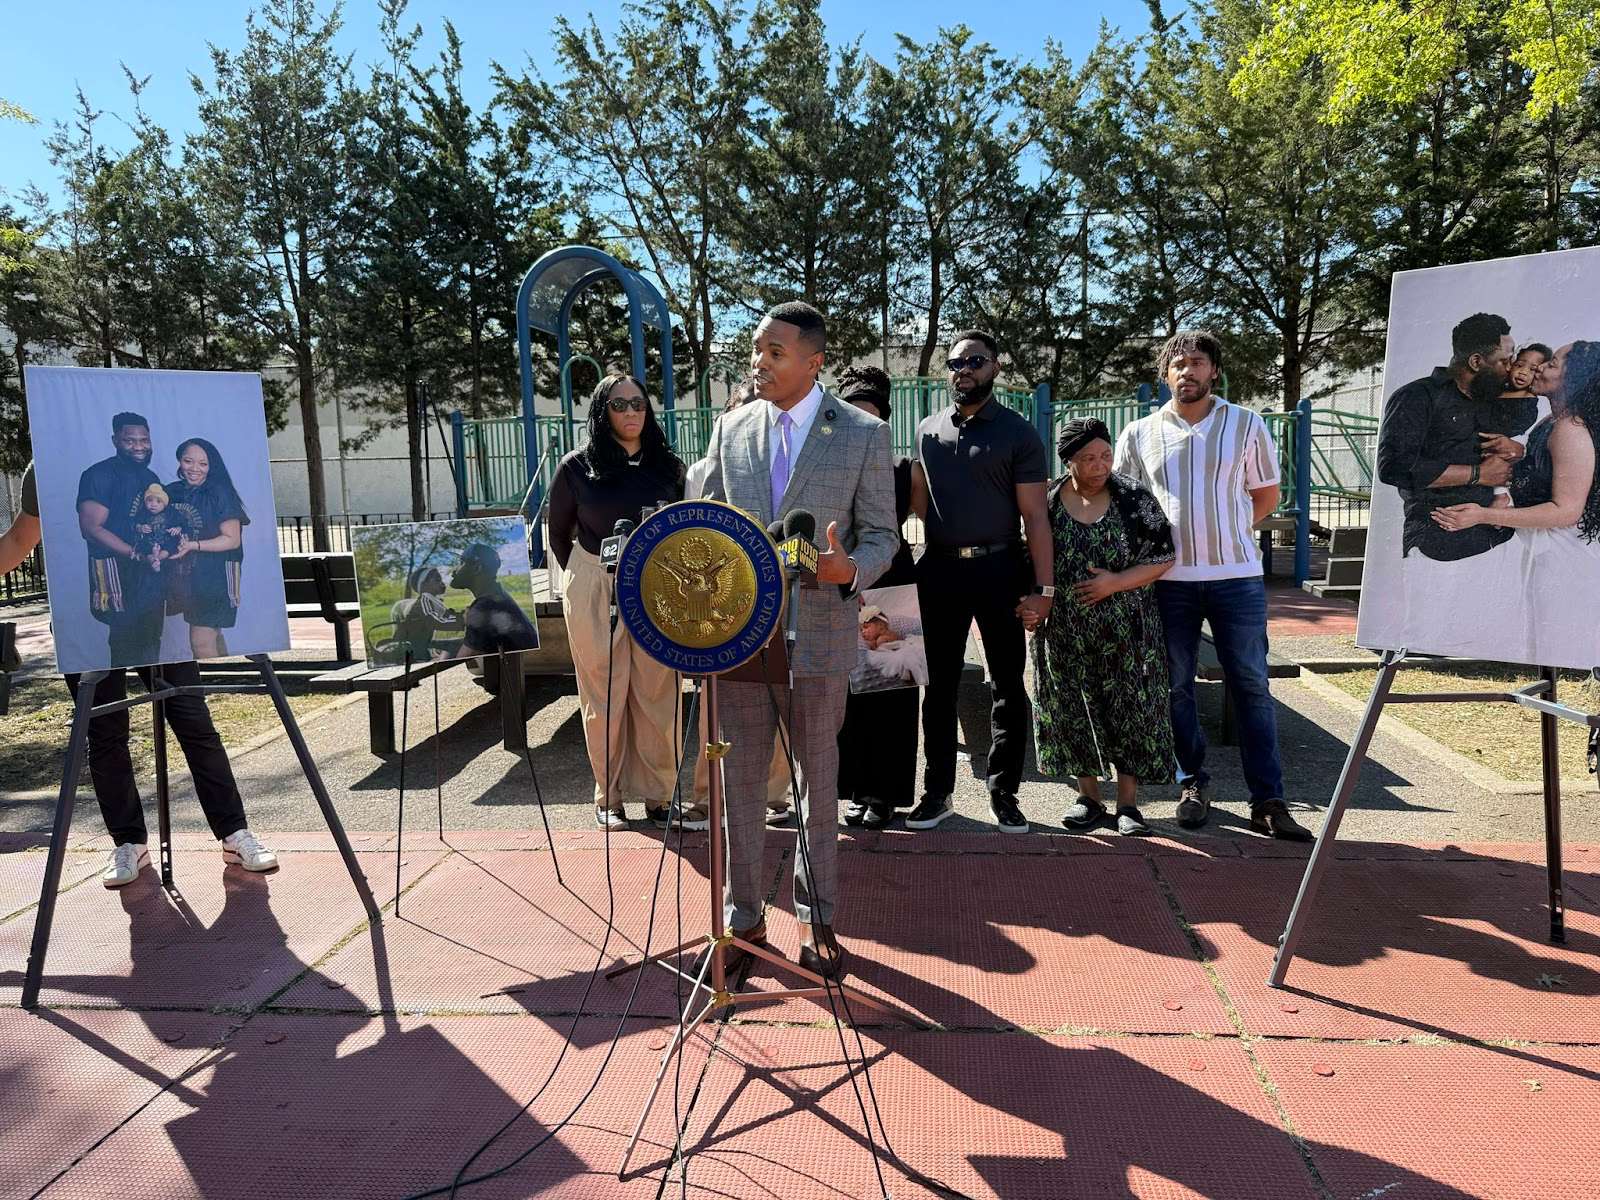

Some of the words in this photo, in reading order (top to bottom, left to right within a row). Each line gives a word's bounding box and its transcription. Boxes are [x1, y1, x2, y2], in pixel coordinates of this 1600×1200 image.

[622, 537, 648, 588] HOUSE
[643, 521, 663, 540] OF
[667, 508, 777, 583] REPRESENTATIVES
[799, 550, 818, 574] WINS
[800, 537, 818, 562] 1010
[623, 596, 663, 653] UNITED
[664, 647, 715, 667] STATES
[718, 648, 737, 664] OF
[740, 590, 777, 652] AMERICA
